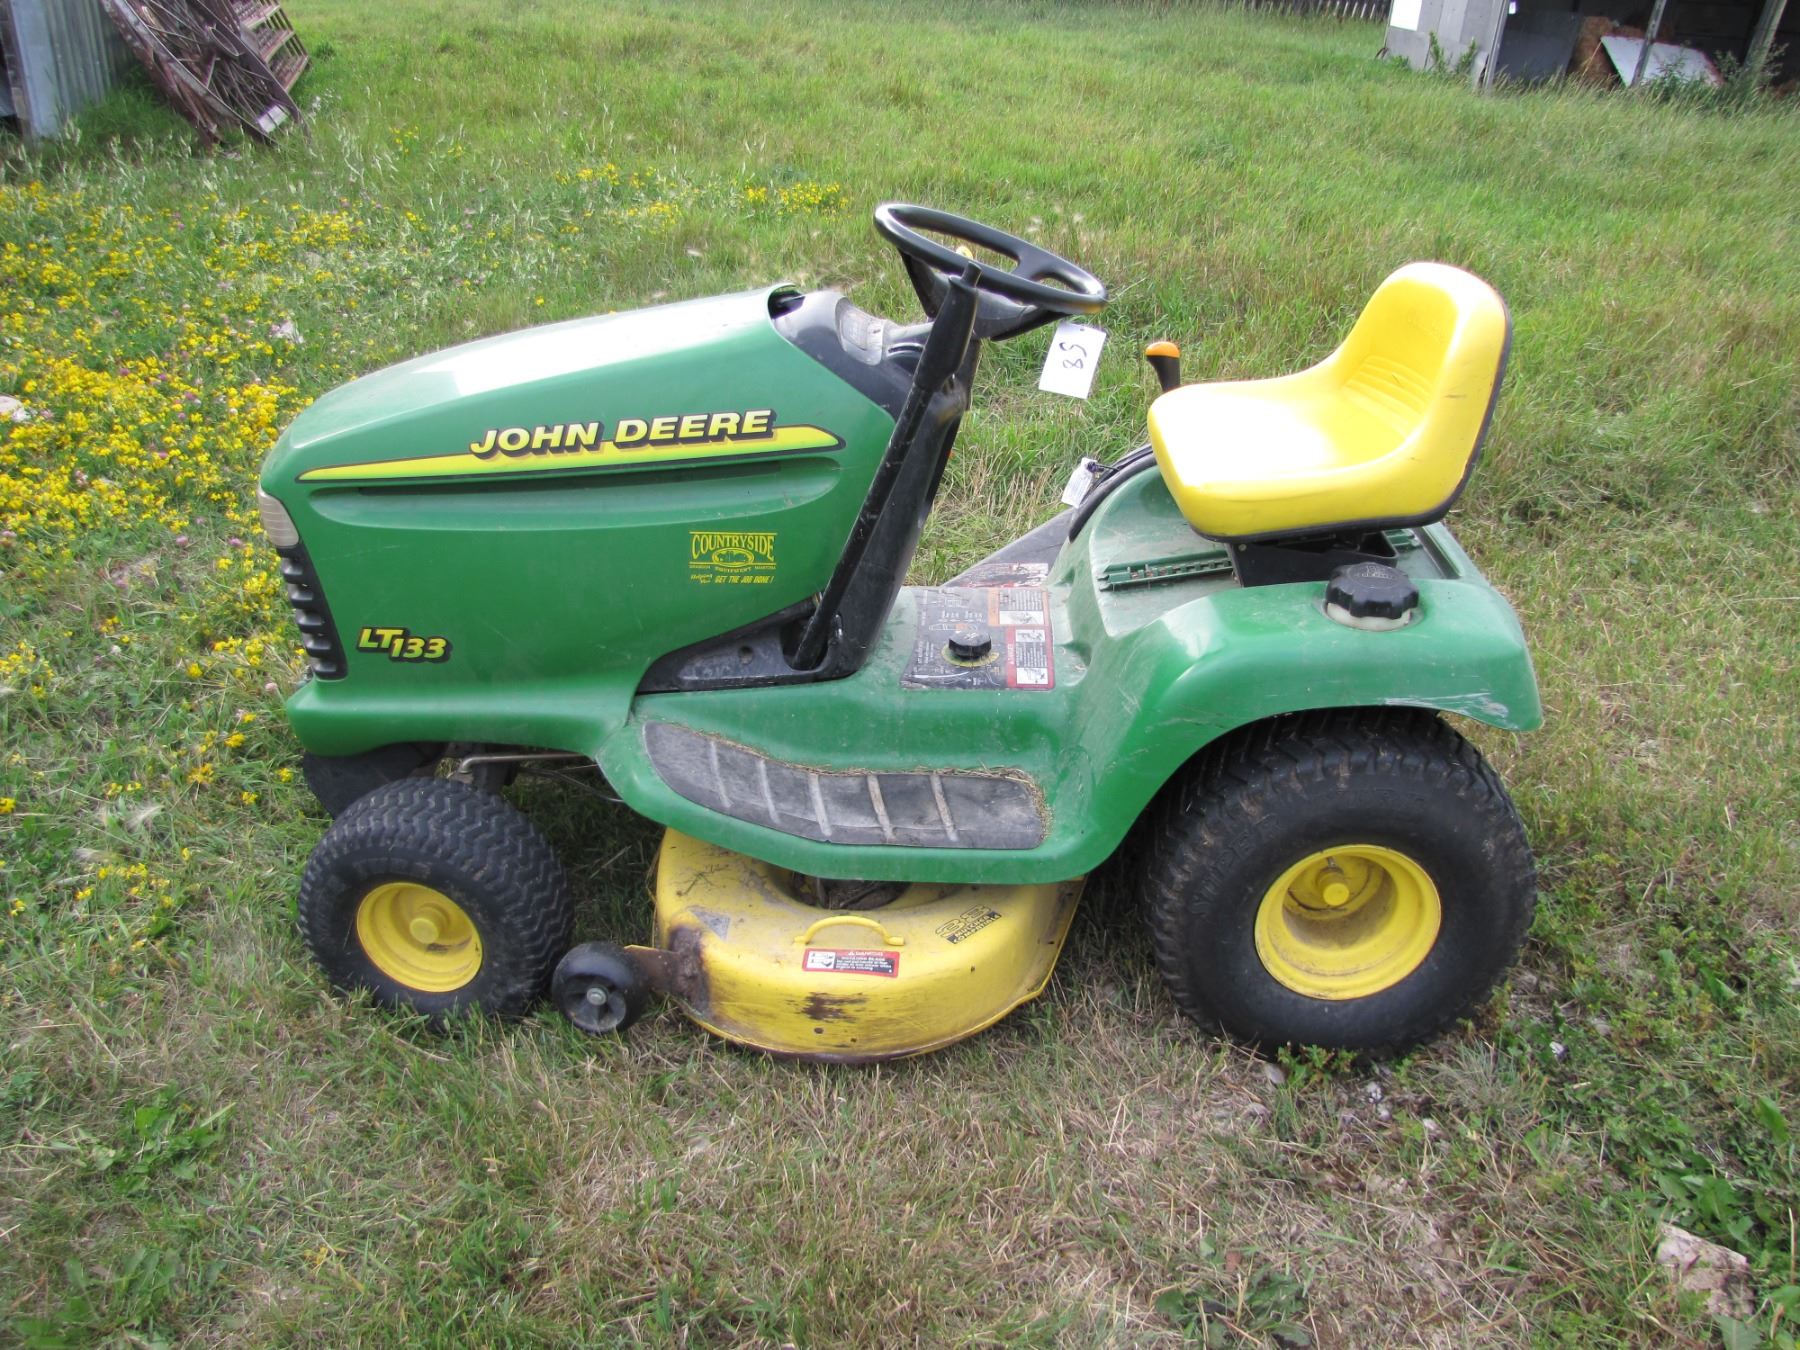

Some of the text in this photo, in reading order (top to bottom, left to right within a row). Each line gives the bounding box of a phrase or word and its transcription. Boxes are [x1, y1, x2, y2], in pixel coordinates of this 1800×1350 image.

[469, 409, 774, 458] JOHN DEERE
[691, 533, 775, 562] COUNTRYSIDE
